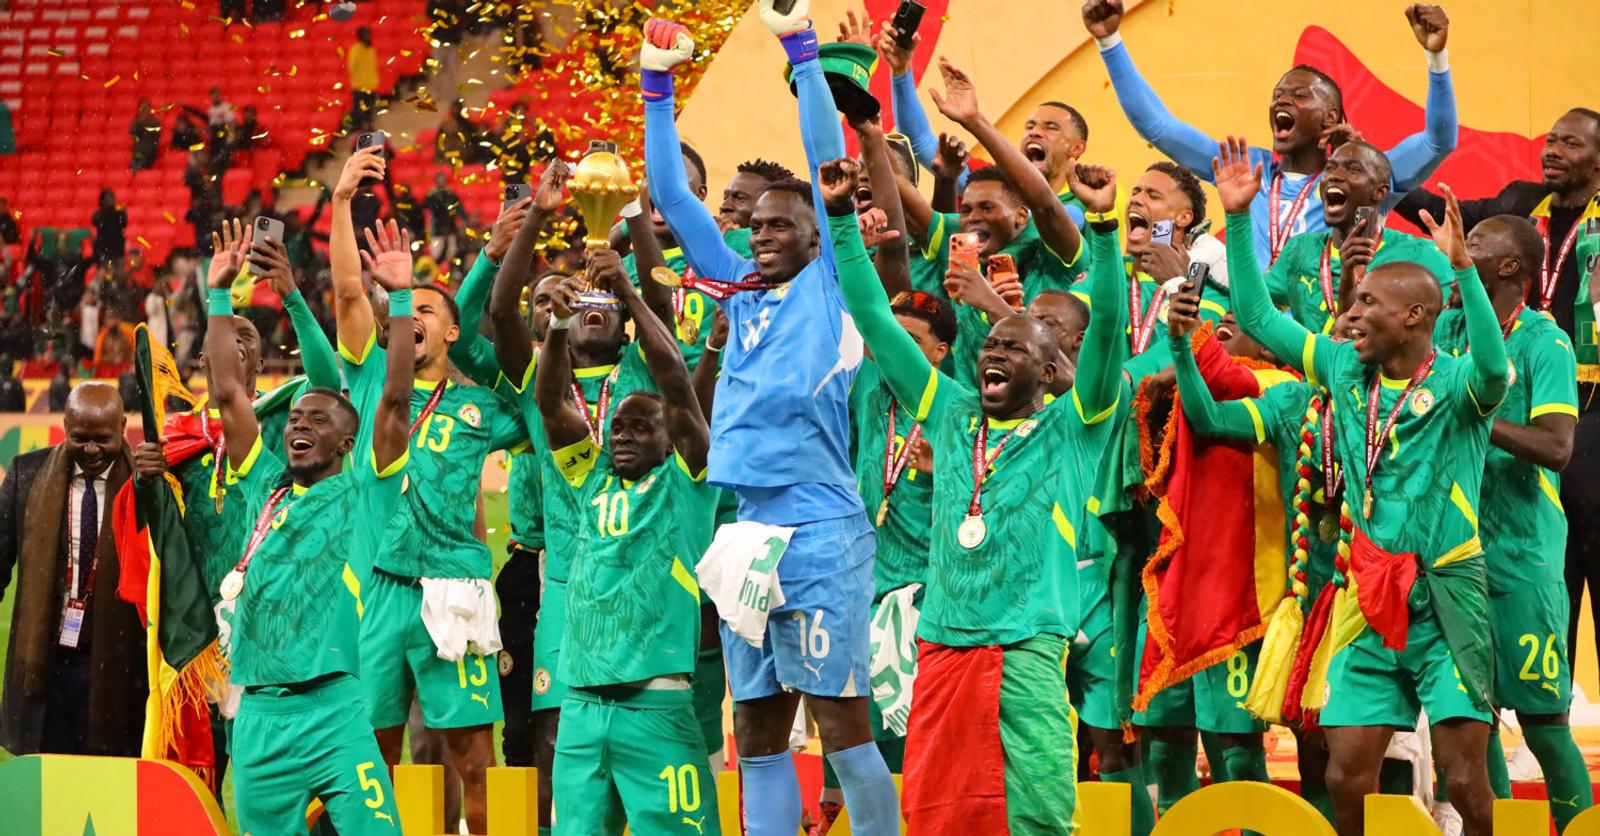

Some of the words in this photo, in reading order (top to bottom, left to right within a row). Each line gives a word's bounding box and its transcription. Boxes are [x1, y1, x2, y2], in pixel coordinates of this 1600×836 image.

[416, 410, 455, 453] 13
[591, 491, 629, 538] 10
[793, 608, 831, 659] 16
[1518, 633, 1559, 680] 26
[1226, 649, 1249, 698] 8
[356, 761, 384, 809] 5
[659, 763, 701, 813] 10
